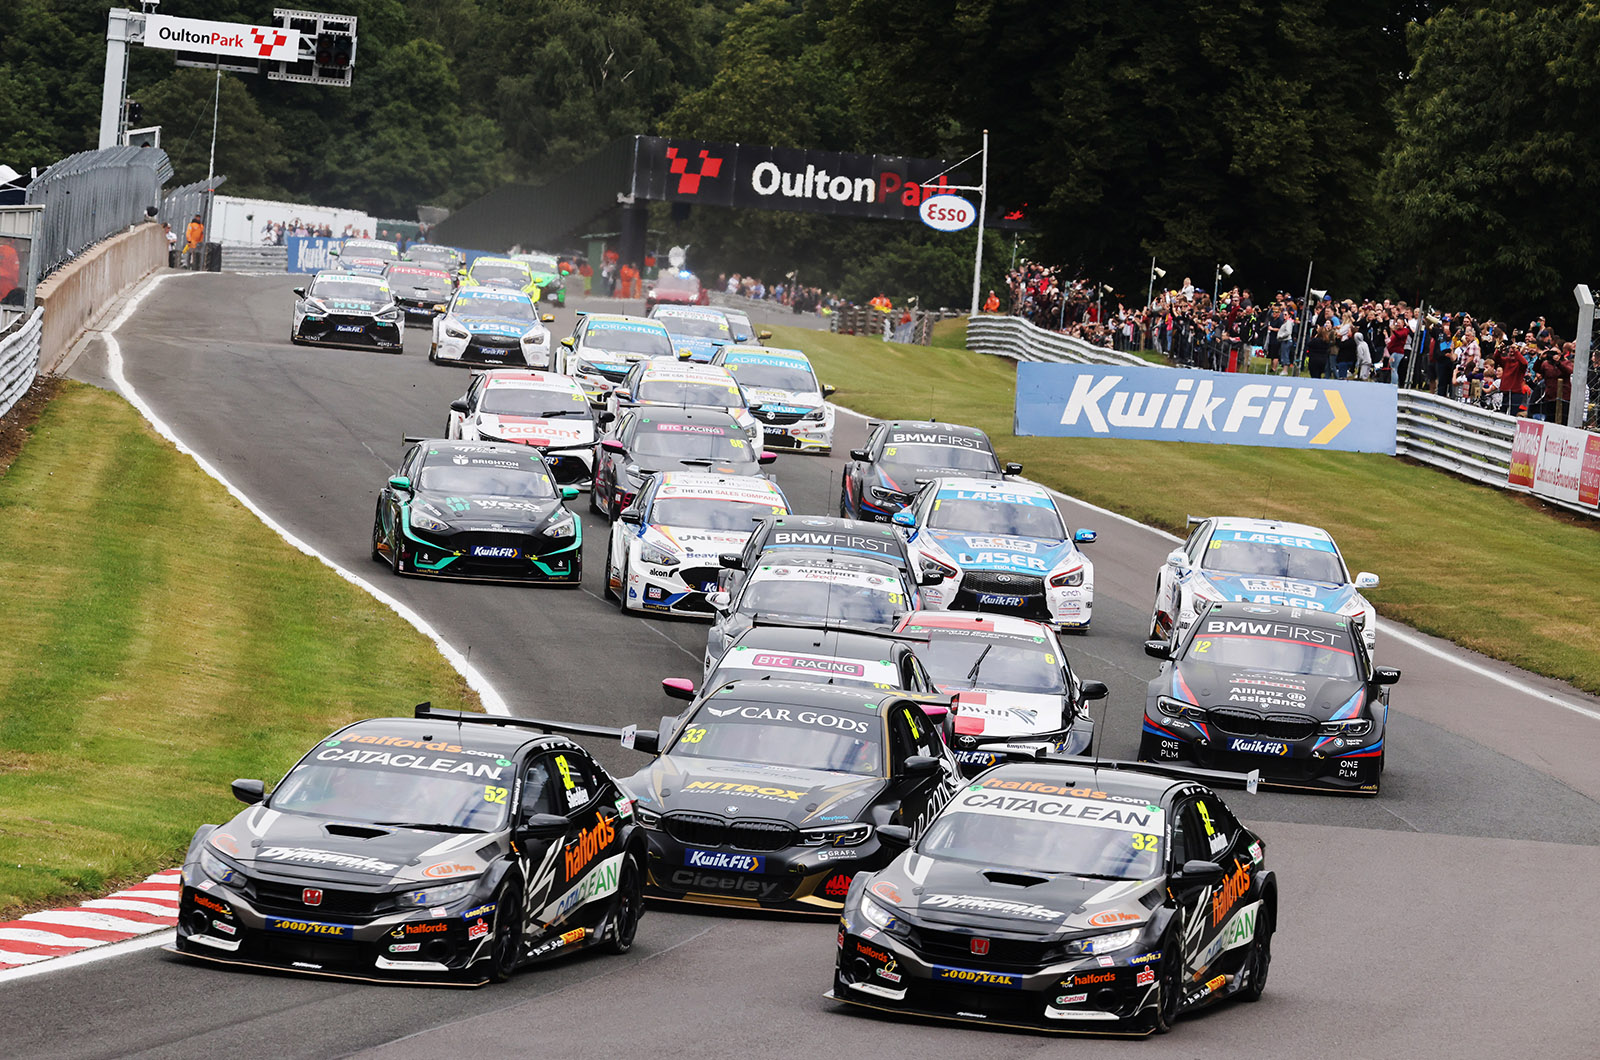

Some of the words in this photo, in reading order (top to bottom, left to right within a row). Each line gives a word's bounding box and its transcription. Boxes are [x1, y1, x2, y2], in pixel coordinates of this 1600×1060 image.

[158, 27, 243, 48] OultonPark
[472, 292, 518, 301] LASER
[334, 302, 371, 311] HUB
[468, 324, 522, 334] LASER
[1060, 374, 1317, 436] KwikFit
[499, 426, 580, 440] radiant
[886, 448, 898, 456] 15
[472, 459, 520, 467] BRIGHTON
[741, 491, 778, 502] COMPANY
[957, 491, 1034, 505] LASER
[934, 500, 942, 511] 1
[1208, 540, 1221, 550] 16
[1233, 532, 1313, 549] LASER
[474, 546, 513, 557] KwikFit
[958, 553, 1050, 571] LASER
[649, 568, 668, 578] alcon
[888, 593, 903, 605] 31
[979, 594, 1021, 606] KwikFit
[1061, 589, 1081, 598] cinch
[1208, 621, 1341, 646] BMWFIRST
[1194, 640, 1212, 653] 12
[757, 655, 791, 666] BTC
[793, 658, 856, 674] RACING
[1045, 653, 1056, 665] 6
[1230, 687, 1284, 698] Allianz
[1229, 694, 1306, 709] Assistance
[740, 706, 793, 722] CAR
[797, 711, 869, 734] GODS
[680, 728, 707, 744] 33
[339, 732, 504, 760] halfords.com
[1161, 740, 1179, 750] ONE
[1231, 739, 1282, 754] KwikFit
[1160, 750, 1179, 758] PLM
[316, 747, 503, 780] CATACLEAN
[1340, 760, 1359, 769] ONE
[1339, 769, 1358, 777] PLM
[484, 785, 508, 805] 52
[680, 788, 715, 796] Fuel
[719, 790, 798, 805] Additives
[685, 781, 808, 801] NITROX
[982, 777, 1150, 806] halfords.com
[962, 793, 1151, 827] CATACLEAN
[565, 811, 615, 882] halfords
[1131, 833, 1158, 853] 32
[689, 851, 752, 870] KwikFit
[671, 869, 778, 895] Ciceley
[553, 862, 618, 924] CATACLEAN
[1213, 858, 1251, 928] halfords
[405, 922, 448, 934] halfords
[468, 917, 489, 938] reis
[856, 942, 888, 963] halfords
[1074, 972, 1116, 985] halfords
[1136, 964, 1155, 984] reis
[1063, 994, 1086, 1002] Castrol
